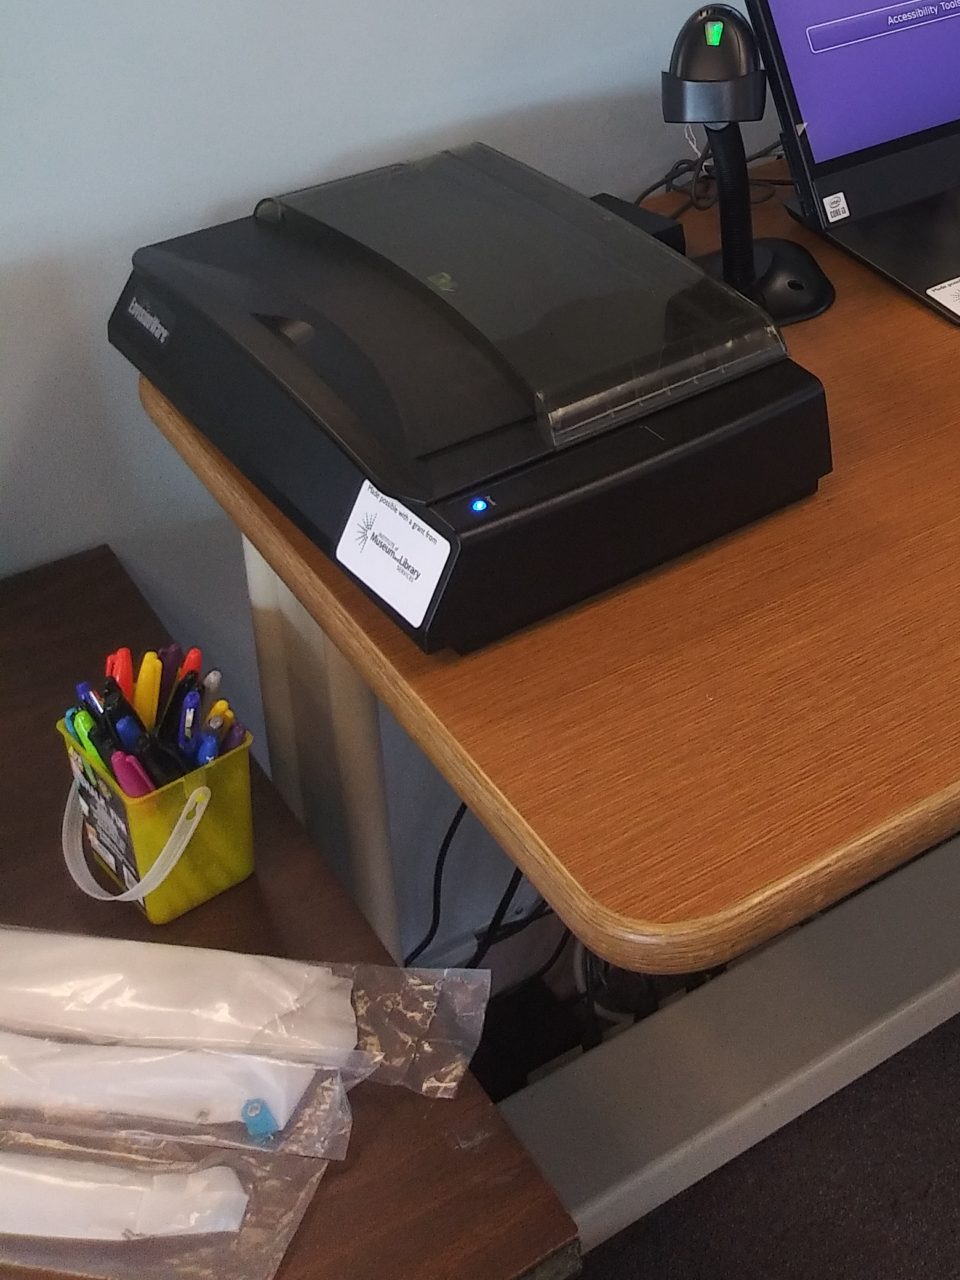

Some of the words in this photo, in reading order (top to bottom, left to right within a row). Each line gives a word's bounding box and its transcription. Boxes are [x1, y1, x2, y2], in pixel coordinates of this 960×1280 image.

[887, 5, 939, 26] Accessibility
[380, 496, 398, 514] possible
[411, 522, 426, 536] grant
[425, 528, 438, 545] from
[370, 531, 396, 560] Museum
[398, 554, 422, 581] Library
